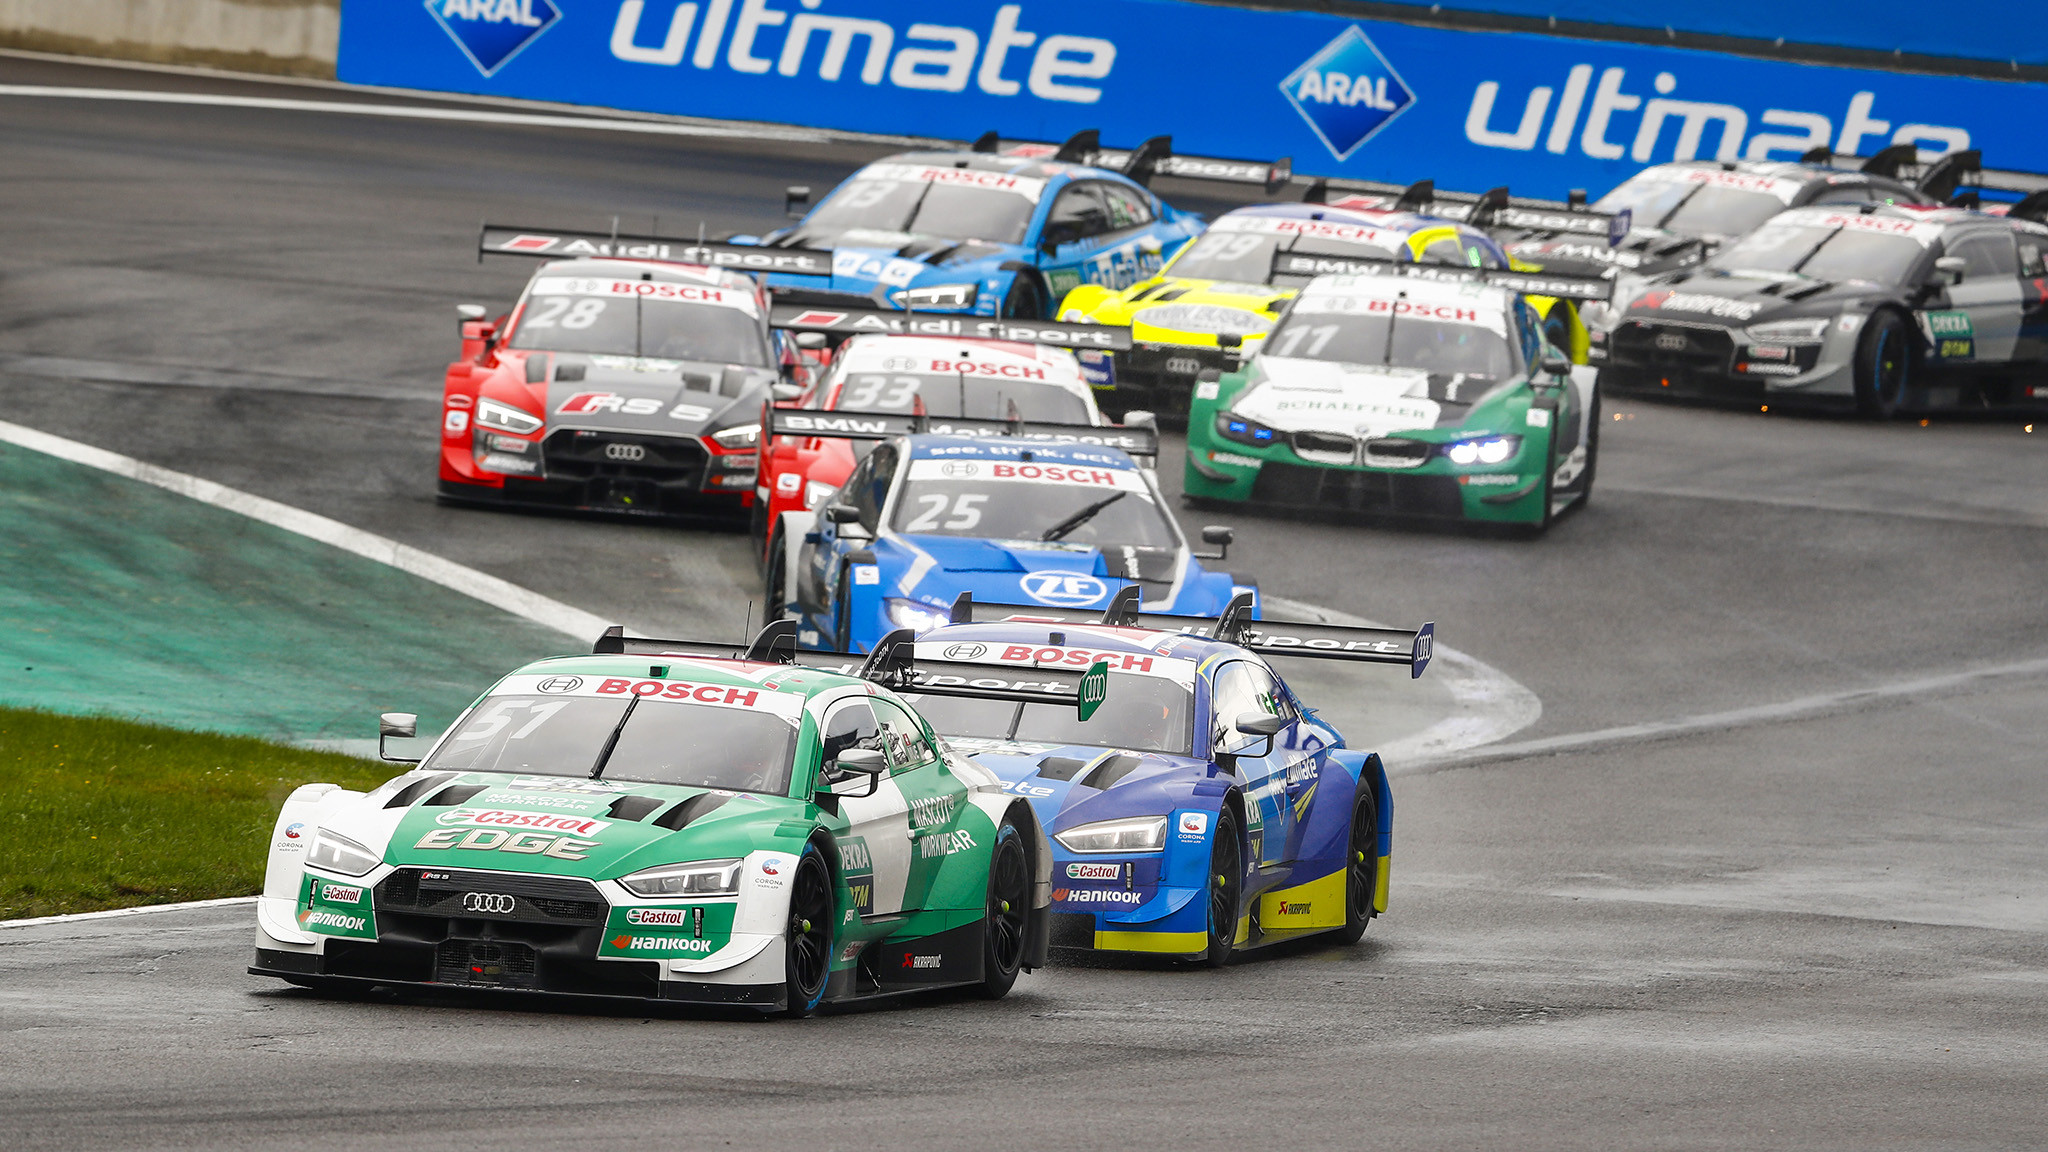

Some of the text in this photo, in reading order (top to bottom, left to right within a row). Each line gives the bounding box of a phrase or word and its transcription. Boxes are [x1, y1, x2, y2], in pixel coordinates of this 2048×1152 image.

[442, 0, 542, 27] ARAL
[610, 0, 1117, 103] ultimate
[1298, 70, 1396, 111] ARAL
[921, 167, 1018, 189] BOSCH
[1275, 220, 1377, 242] BOSCH
[563, 238, 670, 259] Audi
[684, 246, 817, 270] Sport
[611, 281, 723, 302] BOSCH
[523, 297, 607, 329] 28
[1368, 300, 1477, 322] BOSCH
[852, 314, 1113, 346] Audi Sport
[1279, 324, 1341, 357] 11
[930, 359, 1045, 380] BOSCH
[847, 375, 921, 408] 33
[669, 403, 713, 422] 5
[1277, 400, 1425, 419] SCHAEFFLER
[784, 416, 887, 433] BMW
[993, 464, 1116, 486] BOSCH
[906, 494, 989, 531] 25
[1035, 576, 1090, 598] ZF
[1000, 644, 1154, 672] BOSCH
[596, 678, 760, 707] BOSCH
[456, 698, 569, 742] 51
[474, 811, 598, 835] Castrol
[1244, 799, 1261, 825] KRA
[413, 828, 603, 862] EDGE
[919, 829, 978, 859] WORKWEAR
[754, 878, 784, 886] CORONA
[1079, 865, 1117, 878] Castrol
[330, 887, 359, 902] Castrol
[641, 911, 682, 924] Castrol
